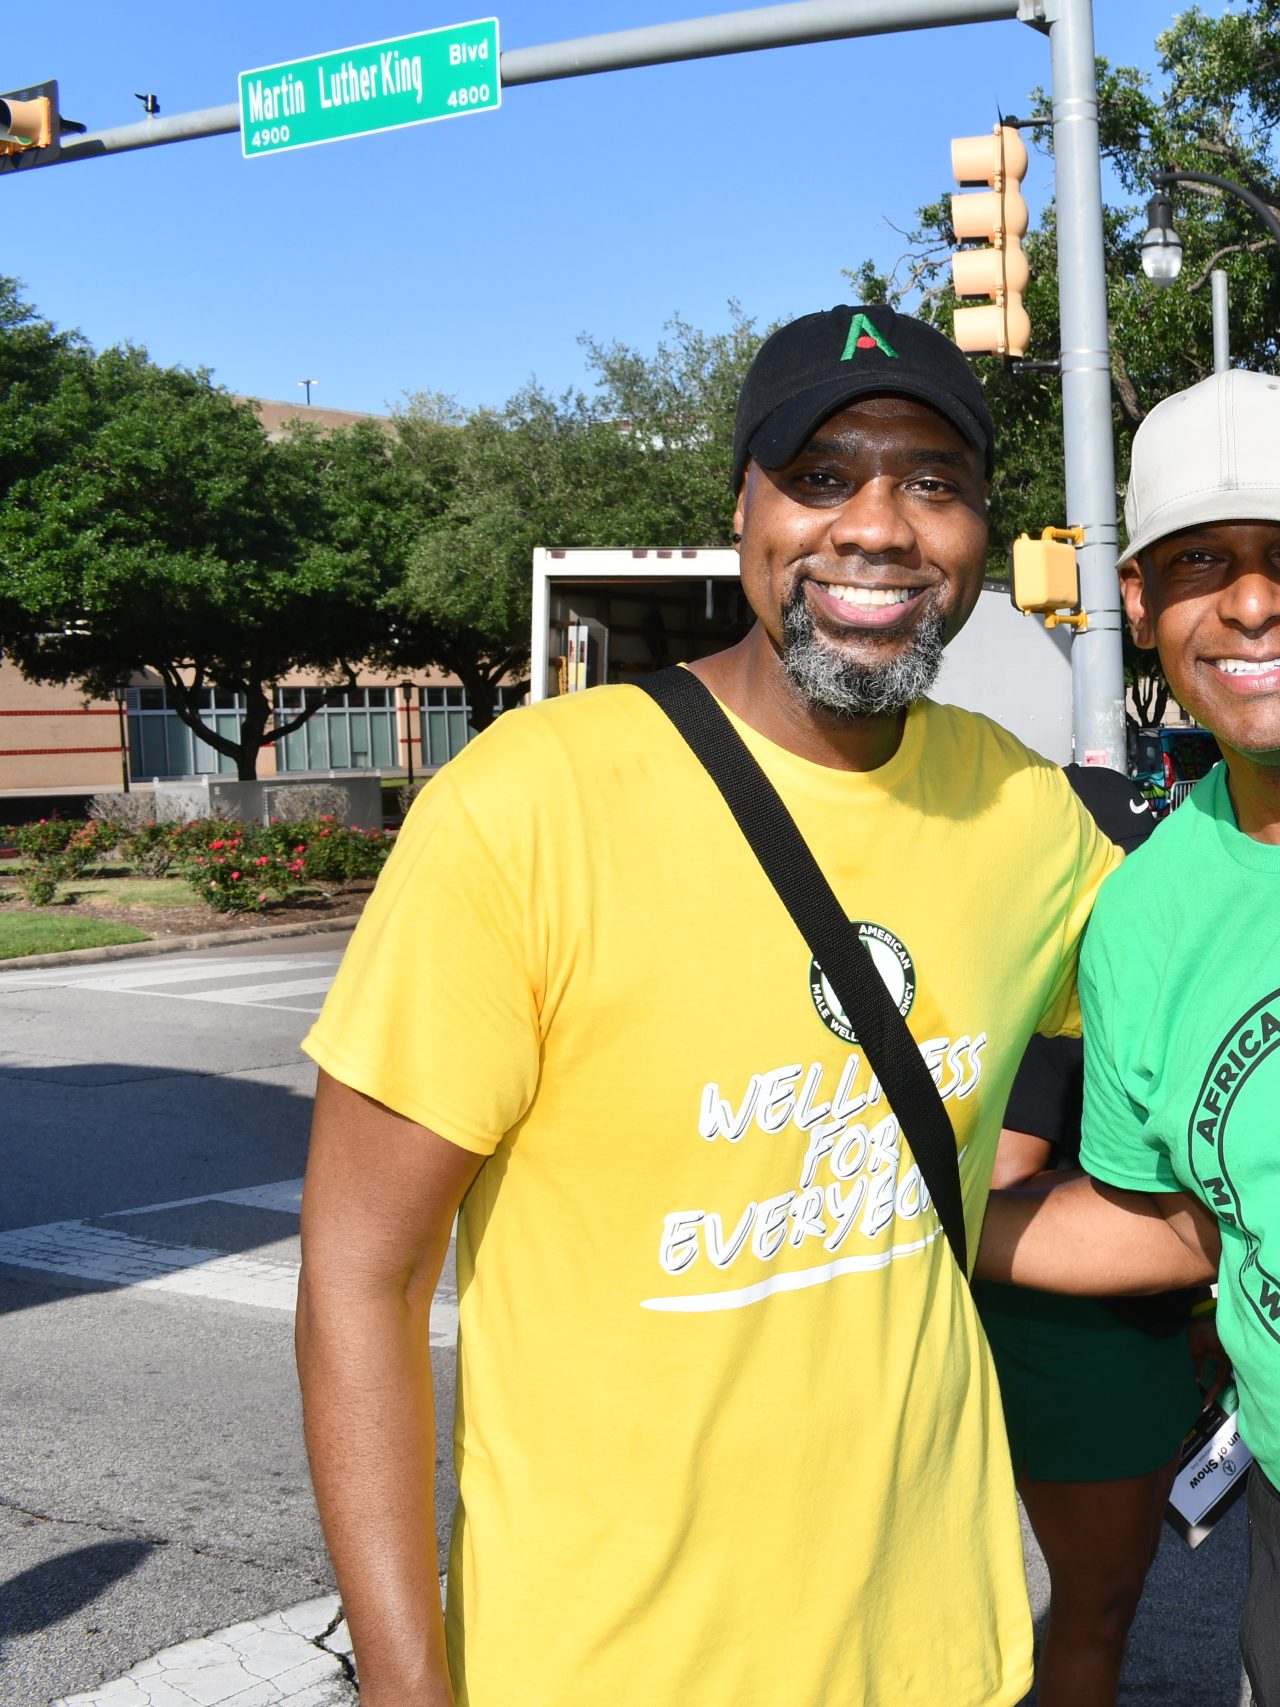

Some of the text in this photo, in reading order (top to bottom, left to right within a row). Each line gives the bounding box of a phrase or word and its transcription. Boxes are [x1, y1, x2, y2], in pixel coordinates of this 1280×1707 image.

[248, 38, 489, 124] Martin Luther King Blvd
[447, 84, 491, 108] 4800
[251, 125, 290, 148] 4900
[859, 924, 912, 970] AMERICAN
[811, 982, 915, 1043] MALE WELL ENCY
[800, 1113, 900, 1189] FOR
[659, 1144, 968, 1276] EVERYBO
[1217, 1446, 1228, 1462] of
[1227, 1431, 1241, 1447] un
[1189, 1458, 1219, 1490] Show
